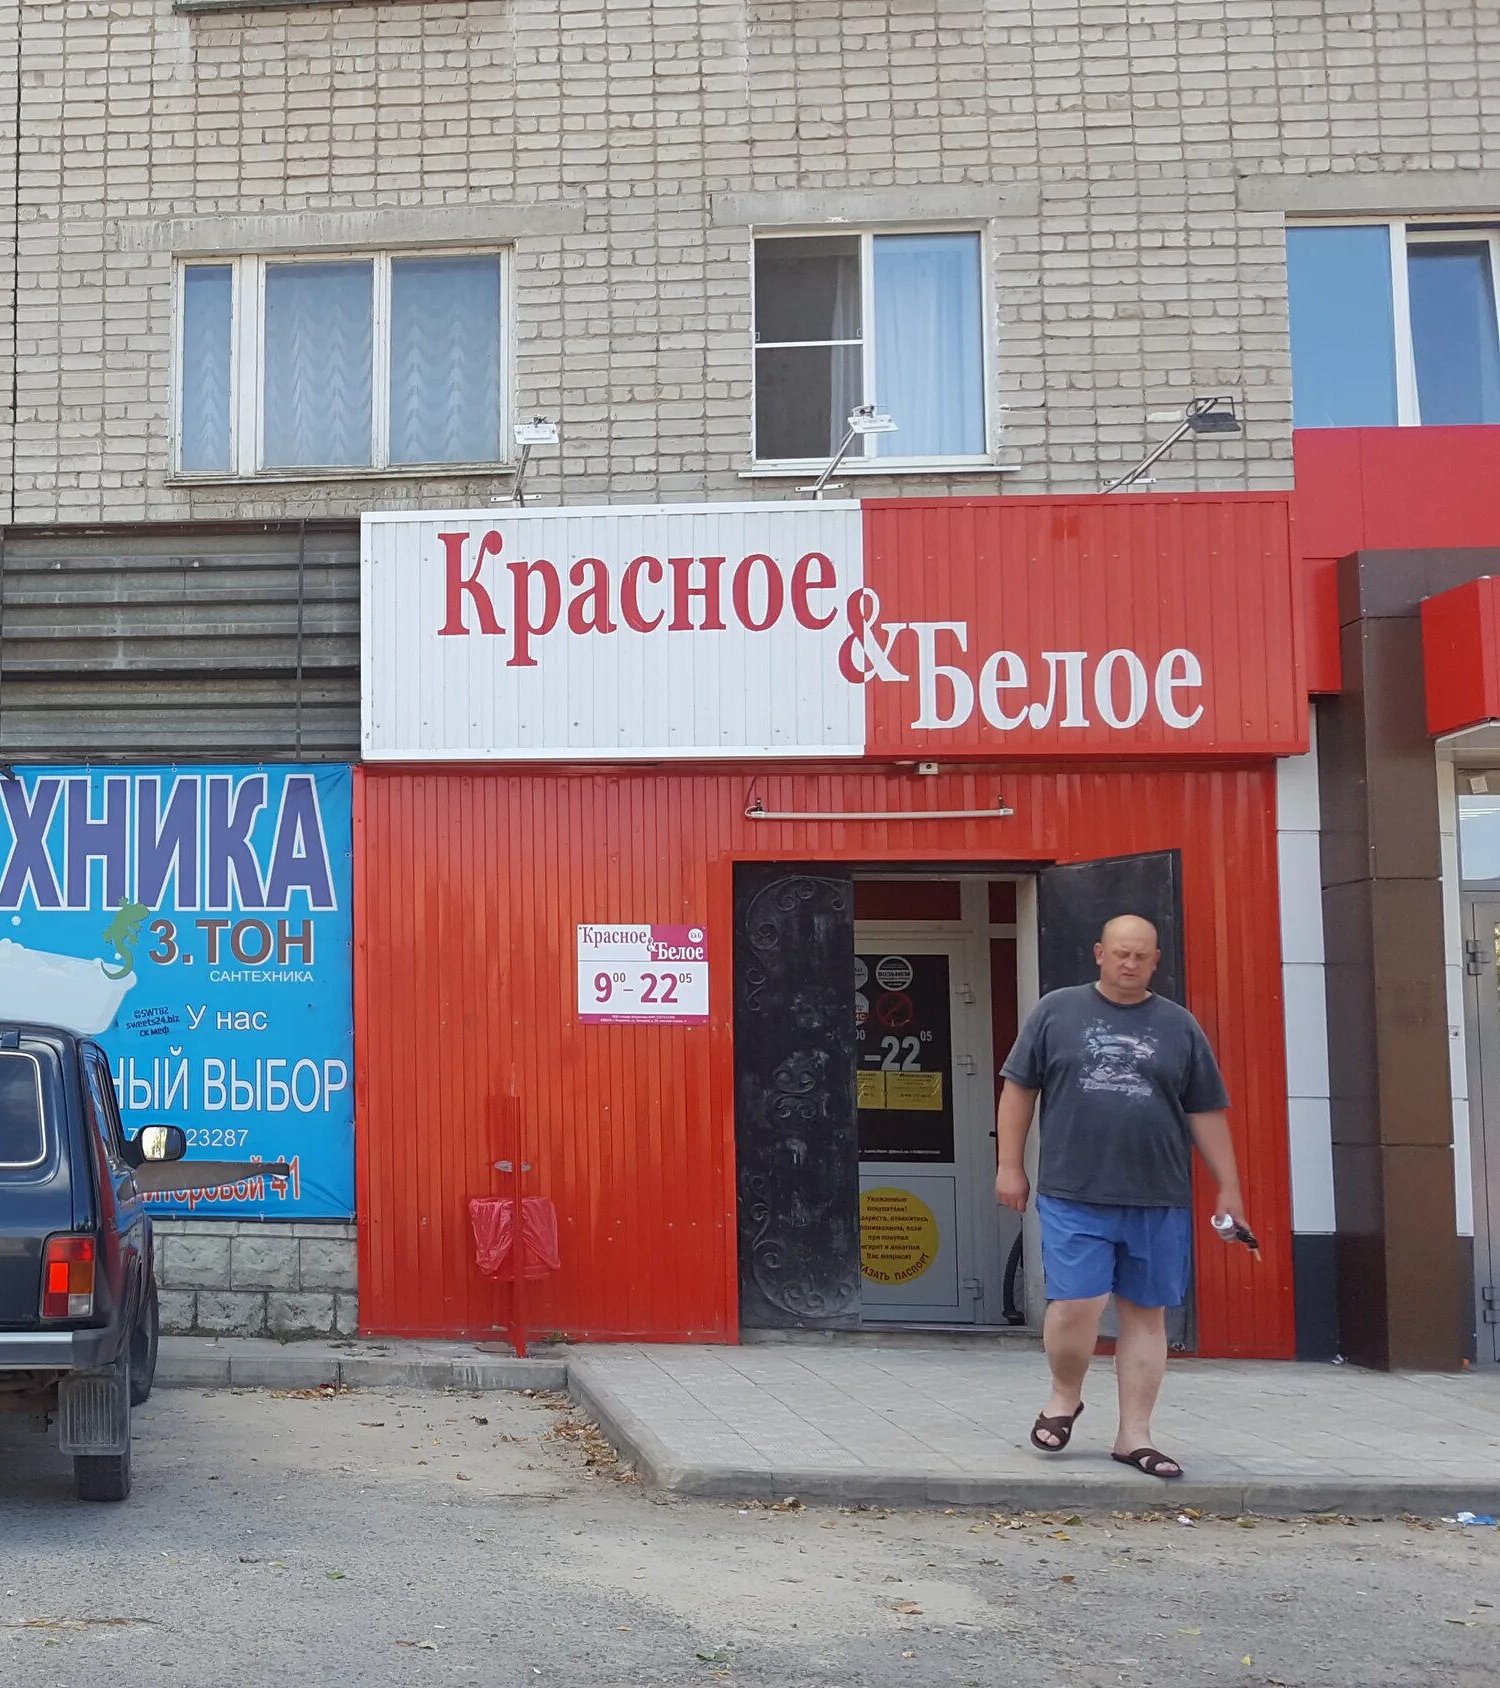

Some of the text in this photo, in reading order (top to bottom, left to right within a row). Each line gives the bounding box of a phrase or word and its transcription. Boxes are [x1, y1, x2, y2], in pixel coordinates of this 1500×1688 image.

[437, 530, 838, 667] Красное
[838, 587, 909, 684] &
[909, 621, 1204, 730] Белое
[582, 926, 647, 948] Красное
[657, 942, 704, 960] Белое
[209, 970, 314, 983] САНТЕХНИКА
[185, 1004, 269, 1031] У нас
[203, 1057, 348, 1112] ВЫБОР
[894, 1252, 930, 1280] ПАСПОРТ
